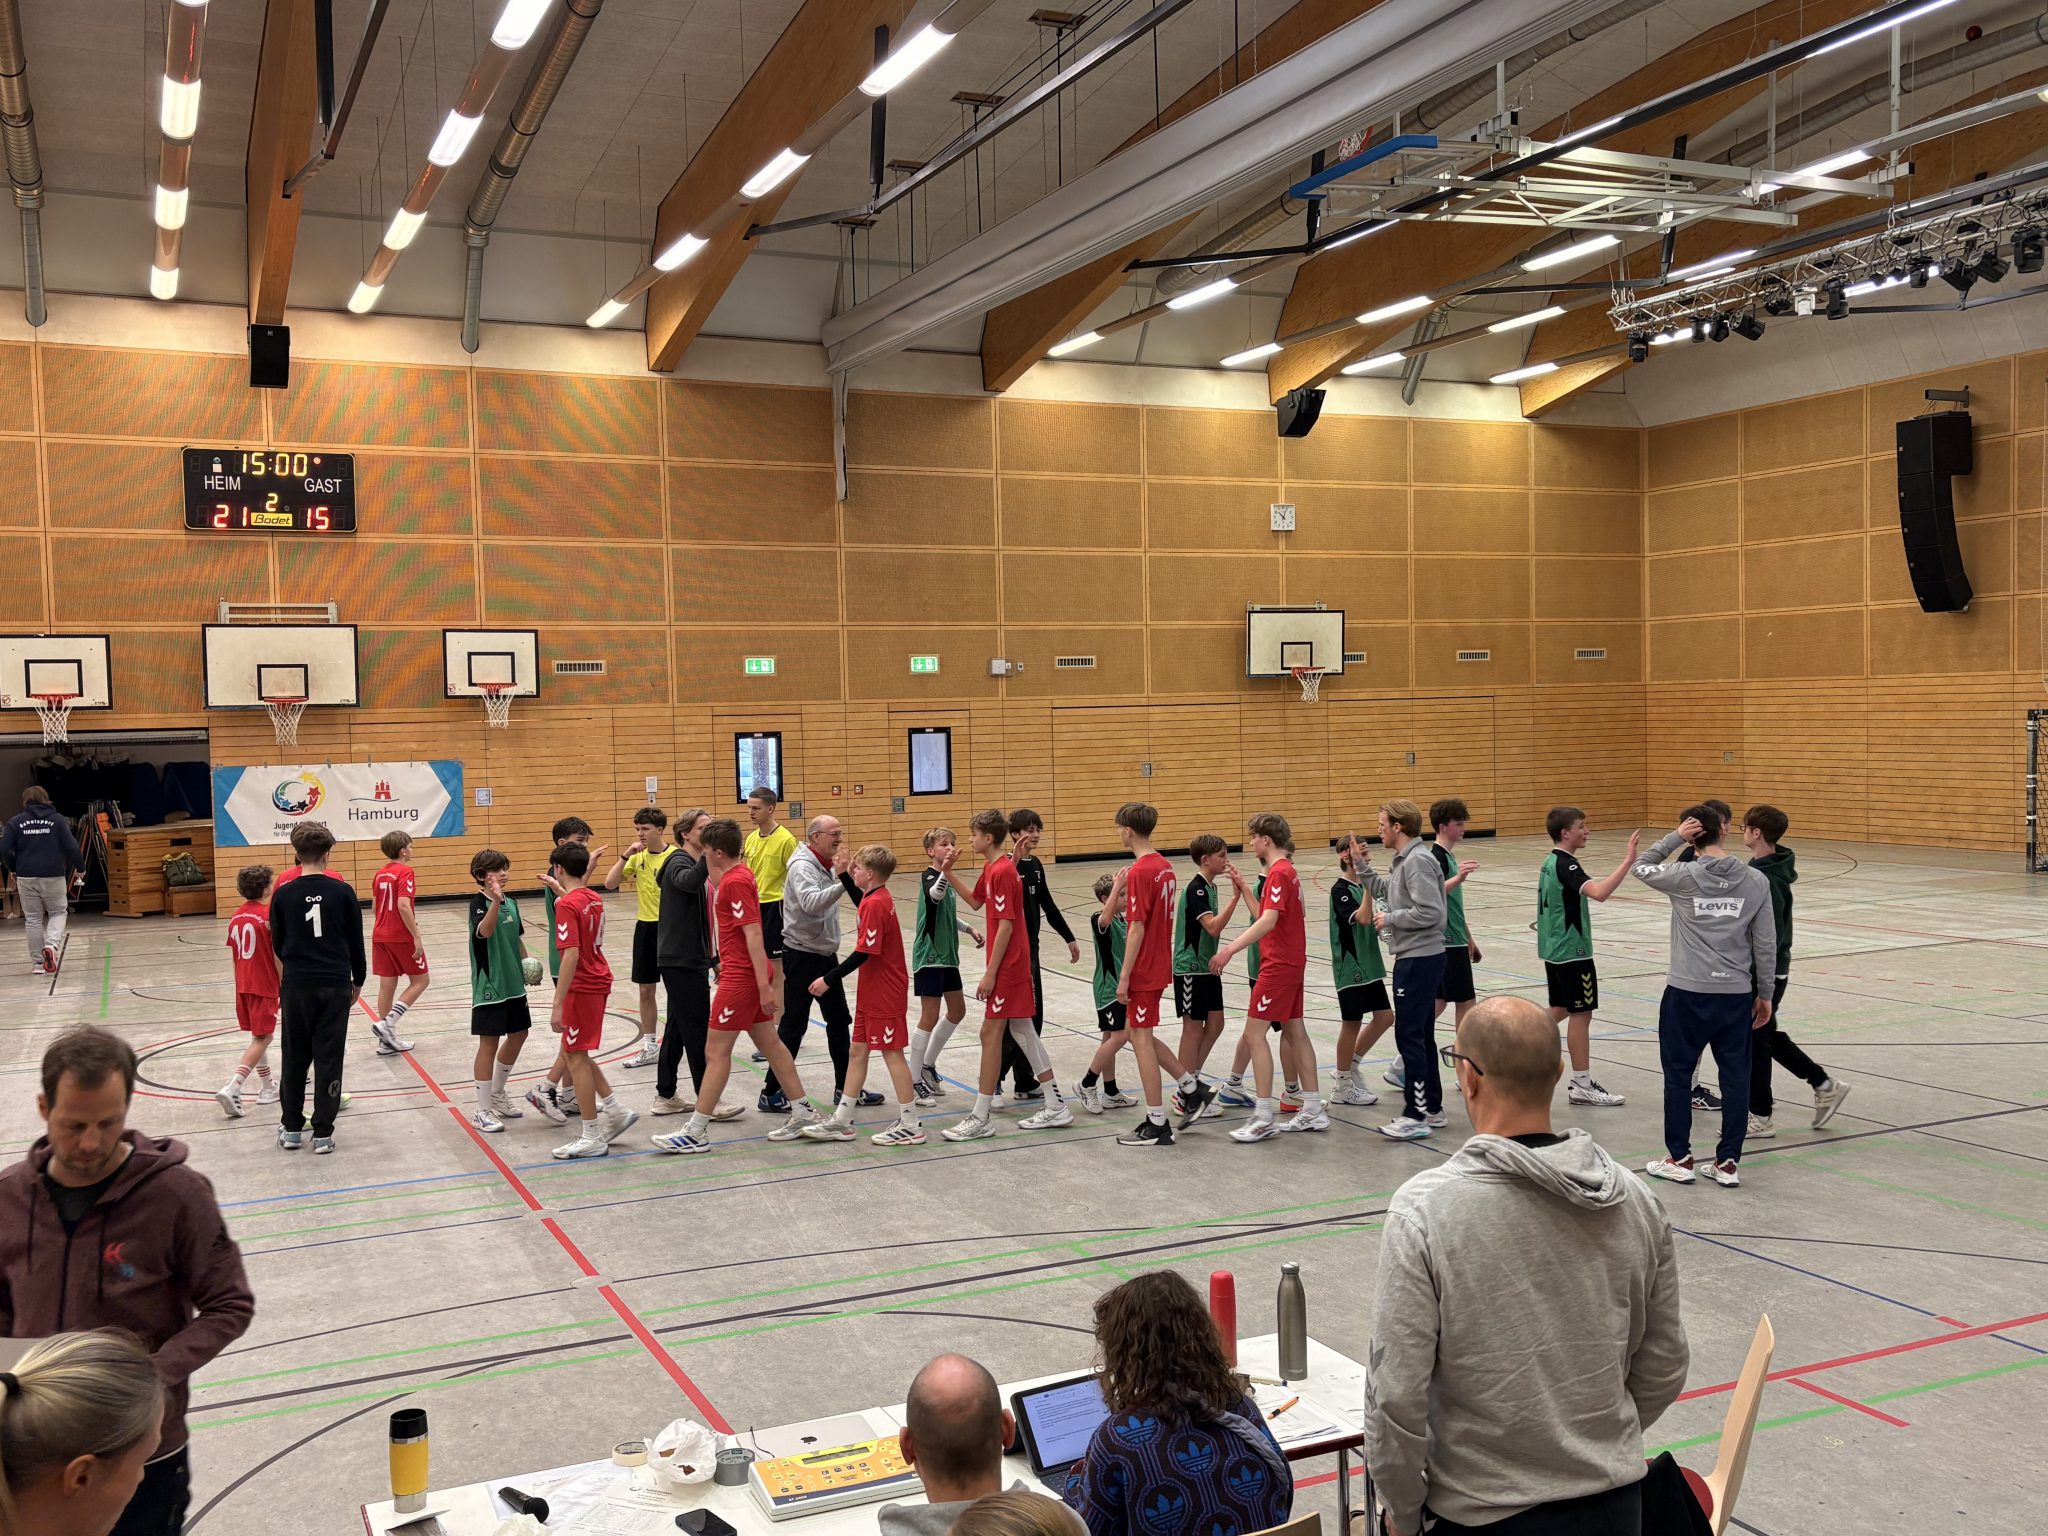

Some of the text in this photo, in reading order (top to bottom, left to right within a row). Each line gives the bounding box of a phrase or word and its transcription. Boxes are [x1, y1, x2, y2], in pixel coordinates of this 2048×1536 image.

[242, 452, 308, 477] 15:00
[204, 475, 241, 491] HEIM
[304, 478, 342, 493] GAST
[265, 493, 279, 512] 2
[214, 504, 248, 528] 21
[253, 514, 291, 525] Bodet
[306, 506, 330, 529] 15
[348, 806, 419, 822] Hamburg
[273, 821, 298, 831] Jugend
[305, 895, 322, 903] CvO
[305, 903, 322, 938] 1
[230, 922, 257, 960] 10
